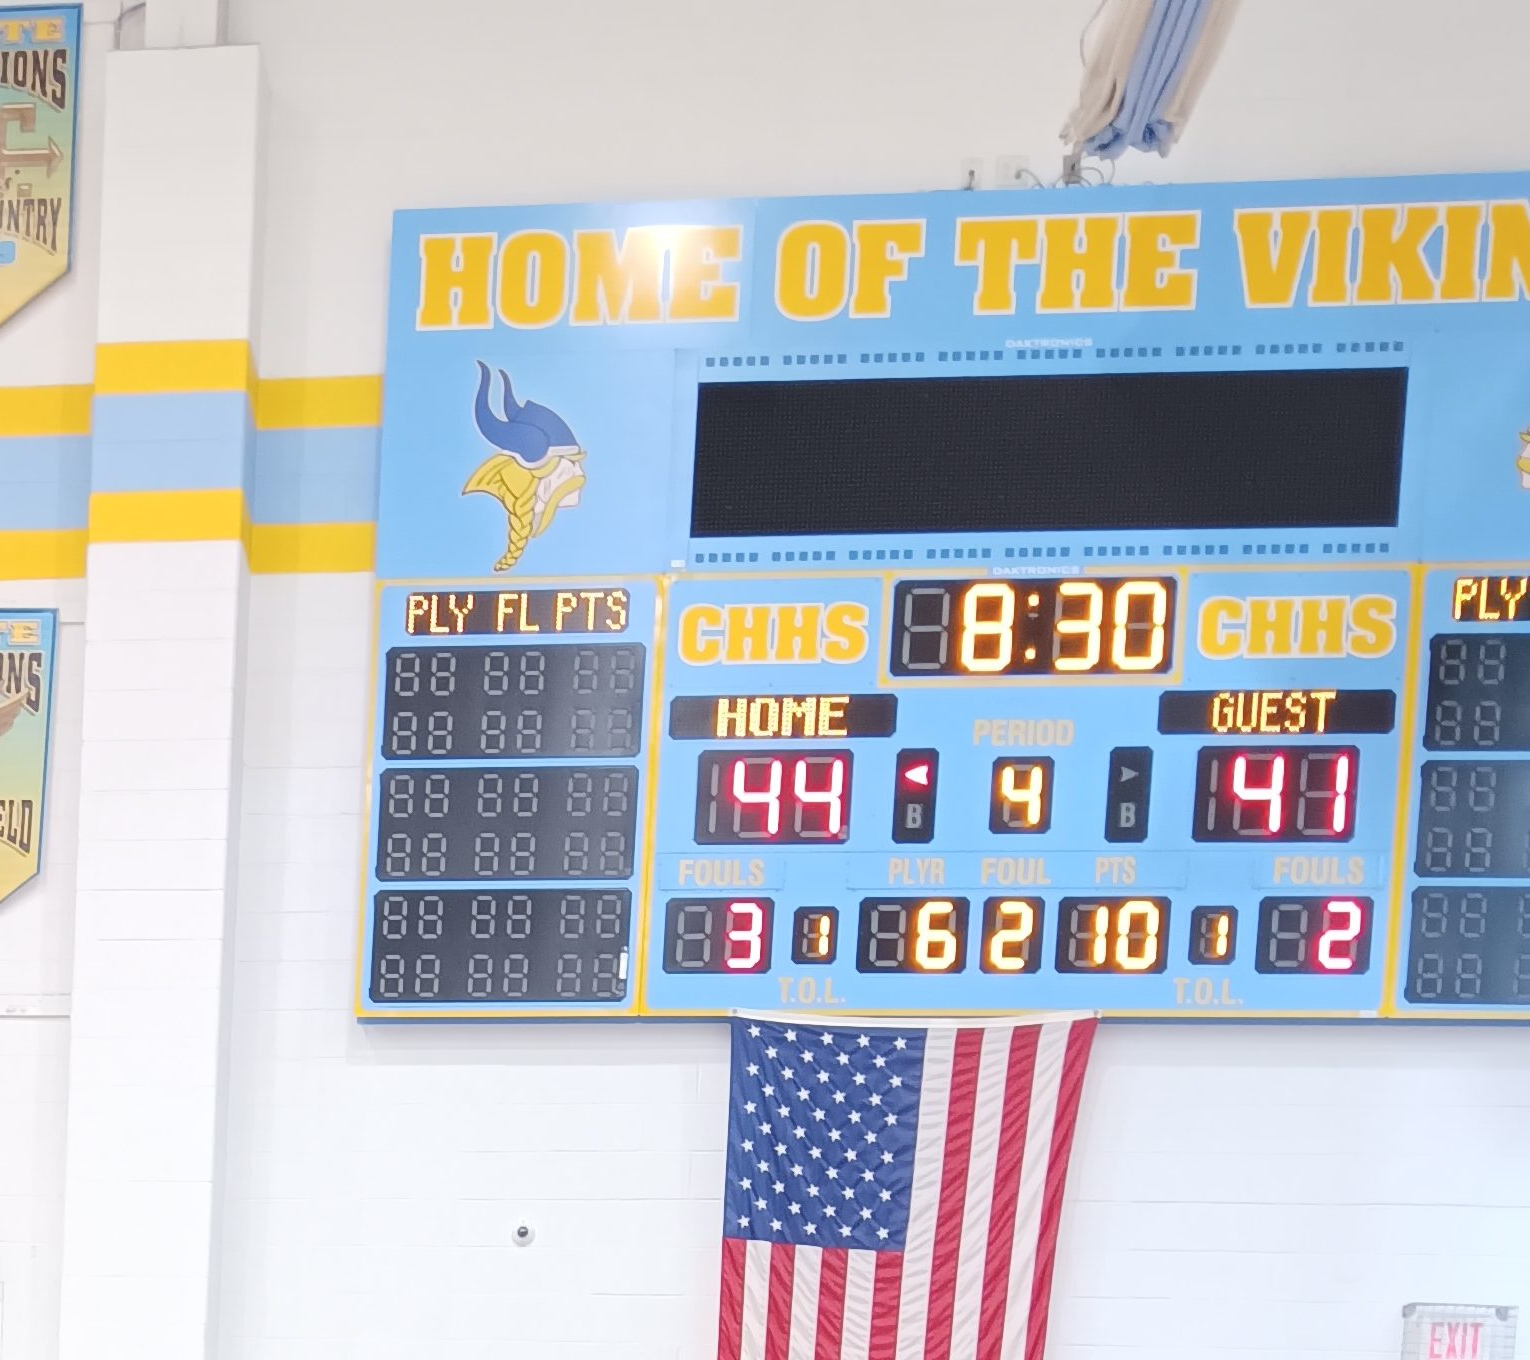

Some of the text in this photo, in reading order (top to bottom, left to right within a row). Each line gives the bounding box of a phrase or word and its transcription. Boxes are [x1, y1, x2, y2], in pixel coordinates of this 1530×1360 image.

[416, 225, 744, 331] HOME
[773, 218, 927, 322] OF
[954, 210, 1202, 315] THE
[407, 590, 628, 634] PLY FL PTS
[960, 582, 1167, 673] 8:30
[1197, 595, 1398, 659] CHHS
[1454, 577, 1528, 620] PLY
[678, 603, 870, 667] CHHS
[716, 696, 850, 737] HOME
[973, 719, 1074, 746] PERIOD
[1211, 691, 1336, 734] GUEST
[732, 759, 845, 835] 44
[1001, 766, 1043, 825] 4
[1232, 754, 1349, 832] 41
[678, 859, 766, 888] FOULS
[888, 859, 945, 886] PLYR
[981, 858, 1051, 885] FOUL
[1095, 857, 1137, 884] PTS
[1273, 858, 1366, 885] FOULS
[726, 902, 763, 967] 3
[915, 901, 958, 969] 6
[990, 902, 1034, 969] 2
[1092, 902, 1159, 969] 10
[1318, 902, 1361, 970] 2
